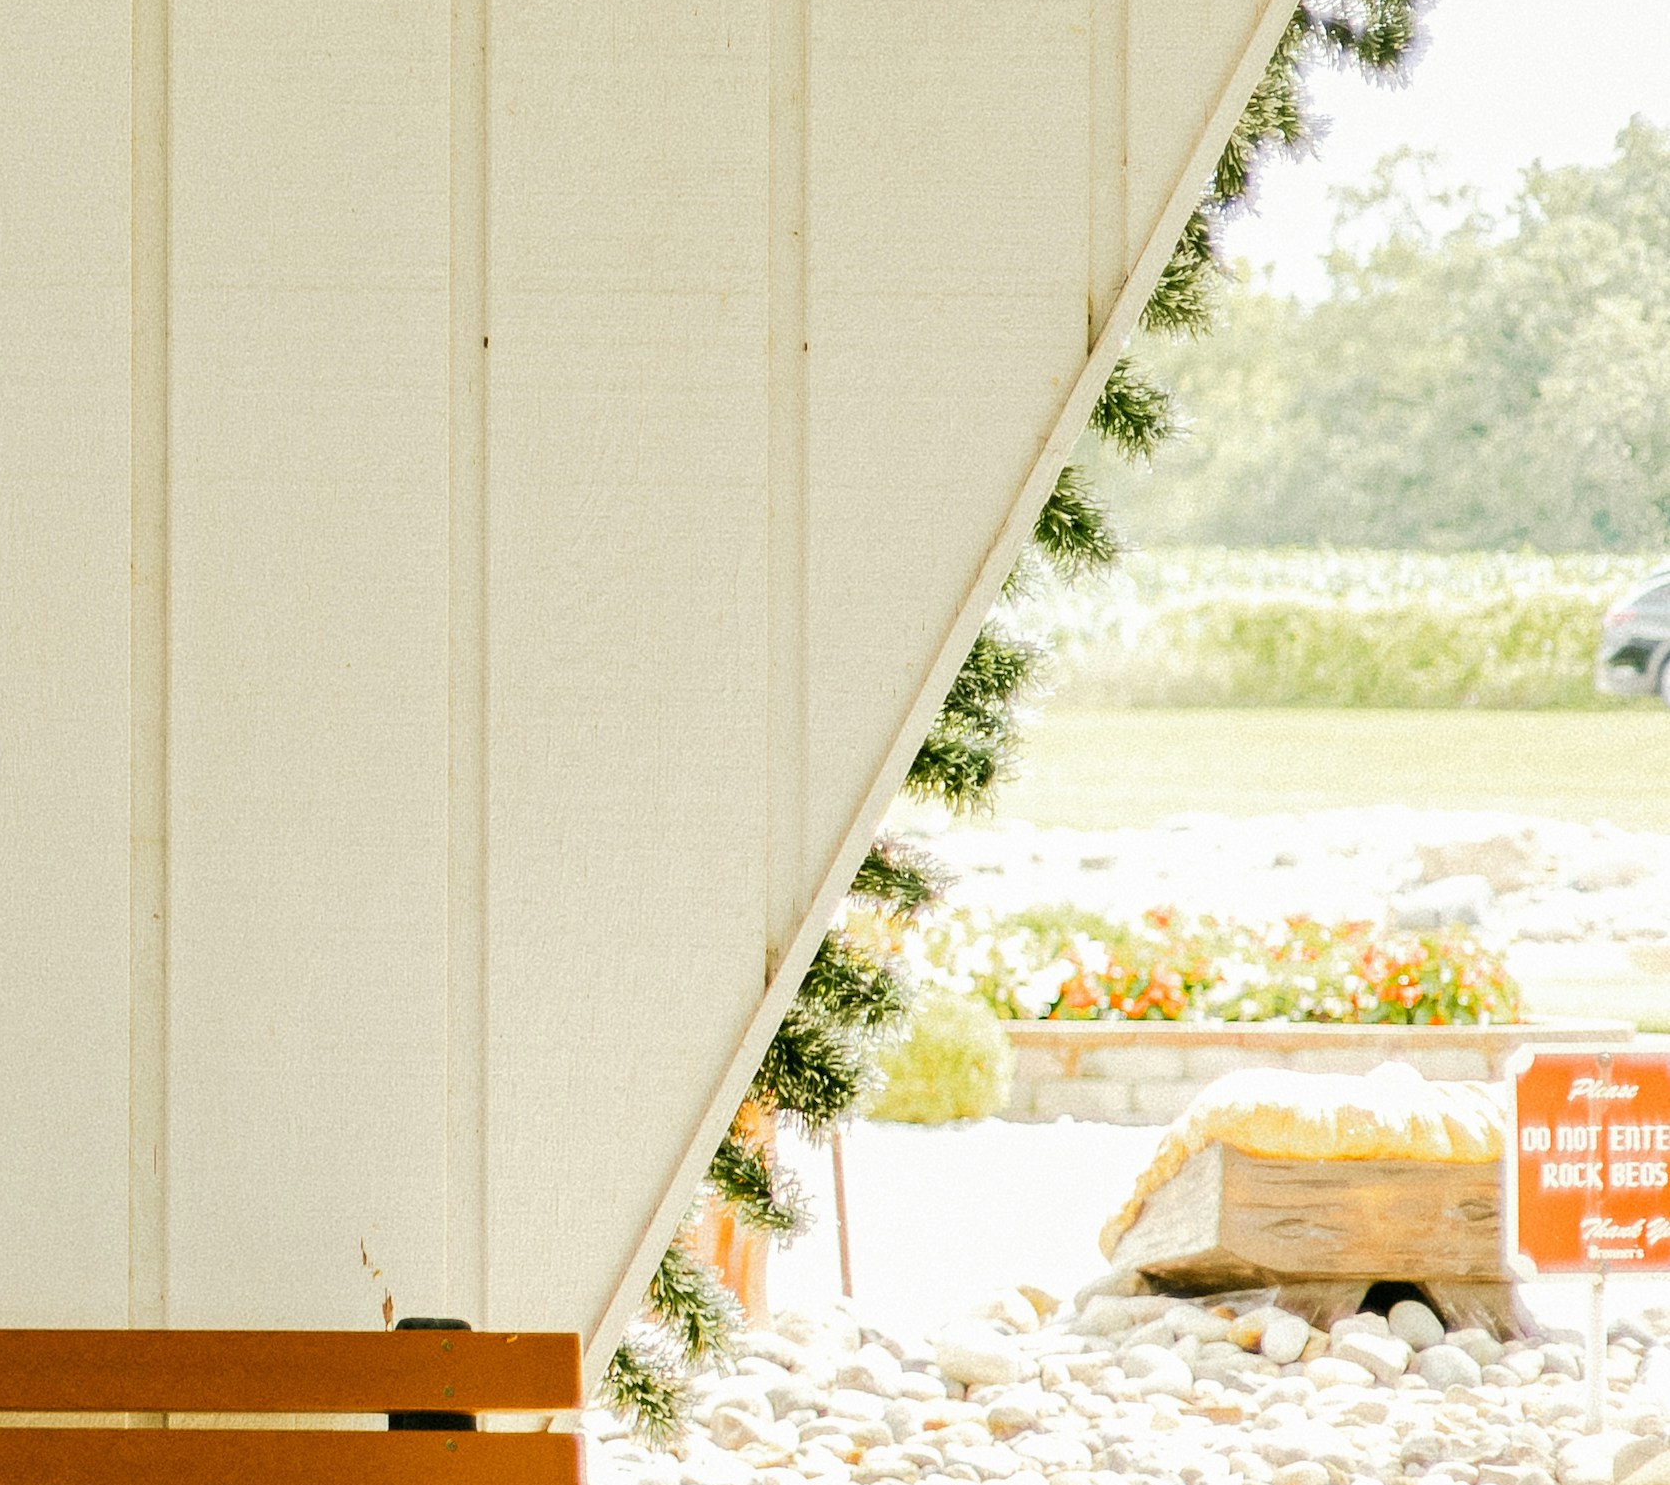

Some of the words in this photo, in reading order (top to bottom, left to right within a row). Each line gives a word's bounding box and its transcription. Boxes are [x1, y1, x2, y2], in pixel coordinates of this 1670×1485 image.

[1567, 1077, 1640, 1102] Please
[1521, 1126, 1551, 1152] DO
[1555, 1125, 1603, 1152] NOT
[1541, 1162, 1604, 1190] ROCK
[1610, 1161, 1669, 1188] BEDS
[1580, 1217, 1647, 1241] Thank
